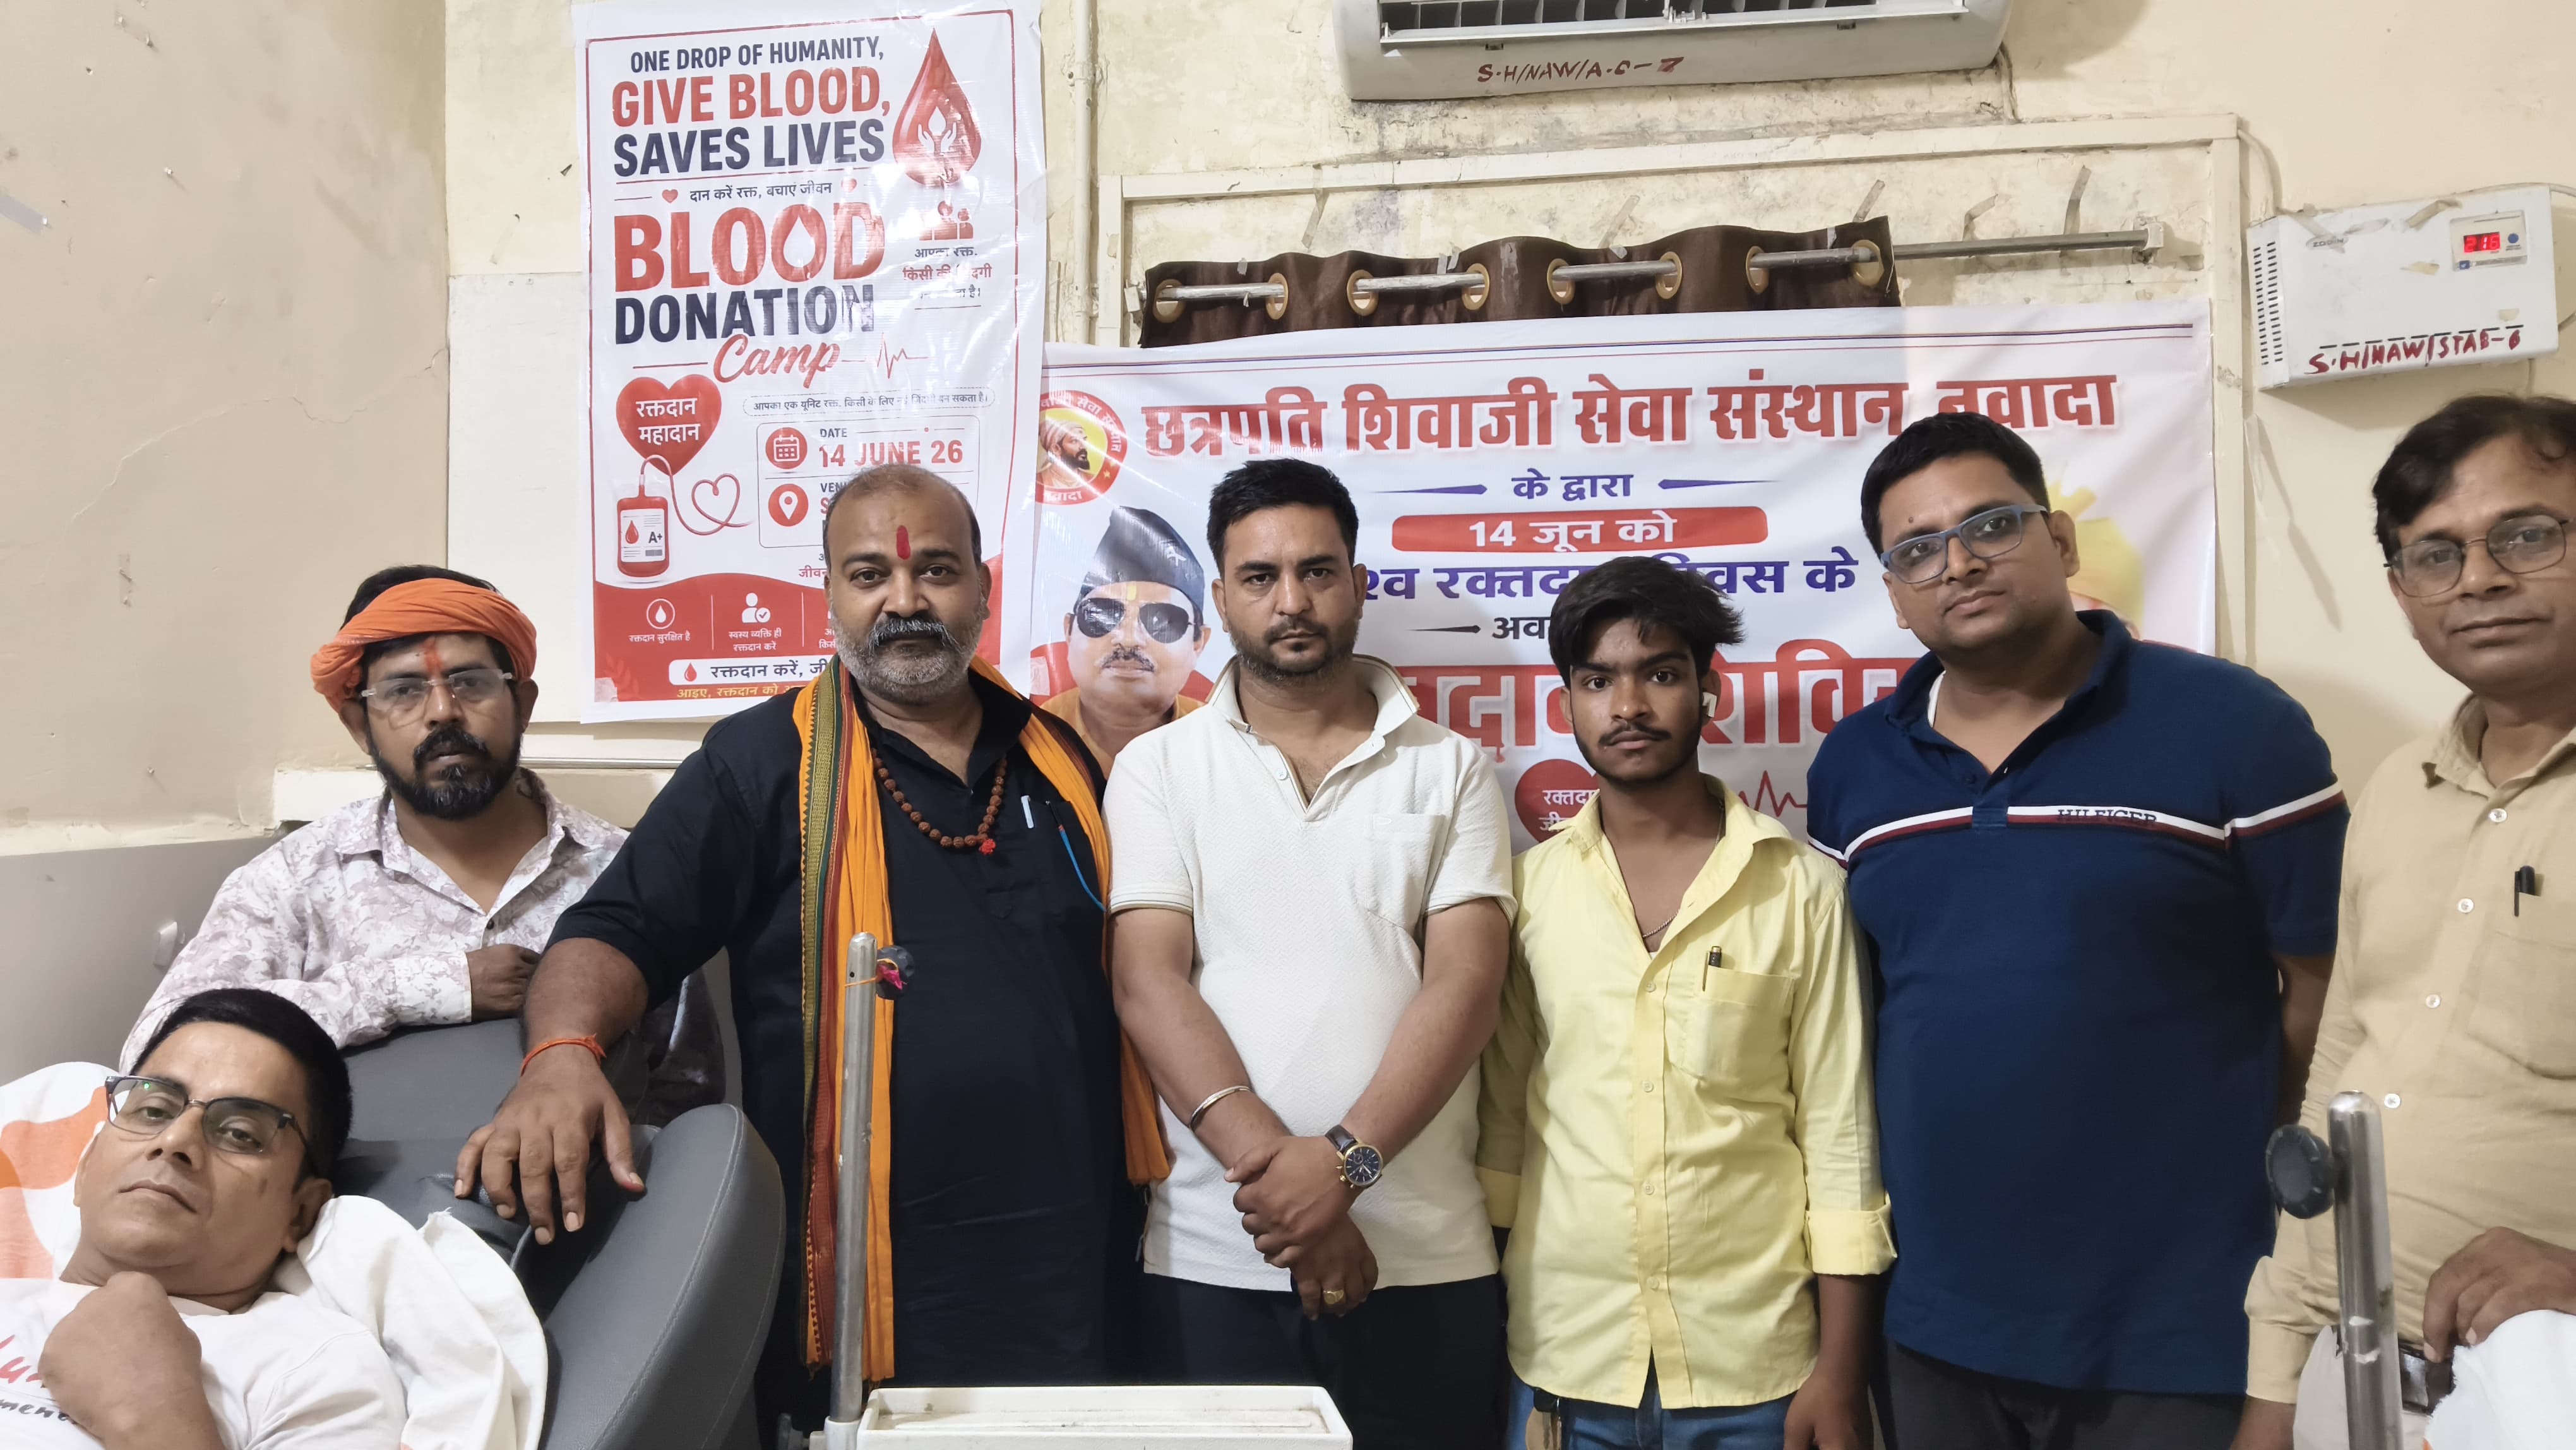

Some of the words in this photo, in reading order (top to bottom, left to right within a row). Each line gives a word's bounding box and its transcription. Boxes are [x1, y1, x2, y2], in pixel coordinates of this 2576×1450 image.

[631, 51, 669, 73] ONE
[677, 45, 730, 69] DROP
[738, 44, 763, 66] OF
[770, 35, 884, 64] HUMANITY,
[612, 75, 714, 127] GIVE
[729, 66, 890, 119] BLOOD,
[614, 126, 751, 177] SAVES
[764, 118, 885, 169] LIVES
[690, 189, 710, 202] दान
[713, 185, 733, 200] करें
[801, 180, 832, 194] जीवन
[614, 202, 885, 292] BLOOD
[616, 284, 874, 345] DONATION
[713, 334, 840, 388] Camp
[635, 398, 698, 417] रक्तदान
[784, 401, 798, 410] एक
[801, 398, 821, 411] यूनिट
[844, 397, 866, 407] किसी
[879, 395, 894, 405] लिए
[951, 394, 977, 404] सकता
[1142, 386, 1327, 456] छत्रपति
[1342, 376, 1558, 450] शिवाजी
[1573, 373, 1692, 445] सेवा
[1707, 368, 1909, 440] संस्थान
[638, 423, 701, 445] महादान
[820, 428, 847, 438] DATE
[819, 444, 845, 467] 14
[854, 441, 921, 467] JUNE
[931, 440, 963, 464] 26
[1512, 468, 1550, 500] के
[1561, 474, 1634, 501] द्वारा
[648, 531, 662, 544] A+
[1469, 520, 1516, 546] 14
[1529, 520, 1604, 553] जून
[1616, 510, 1677, 542] को
[1803, 546, 1859, 592] के
[629, 633, 655, 643] रक्तदान
[657, 630, 683, 644] सुरक्षित
[684, 630, 690, 642] है
[729, 630, 749, 640] स्वस्थ
[750, 628, 772, 638] व्यक्ति
[774, 627, 782, 638] ही
[733, 643, 761, 652] रक्तदान
[710, 664, 766, 678] रक्तदान
[773, 659, 802, 678] करें,
[717, 686, 757, 697] रक्तदान
[762, 683, 778, 695] को
